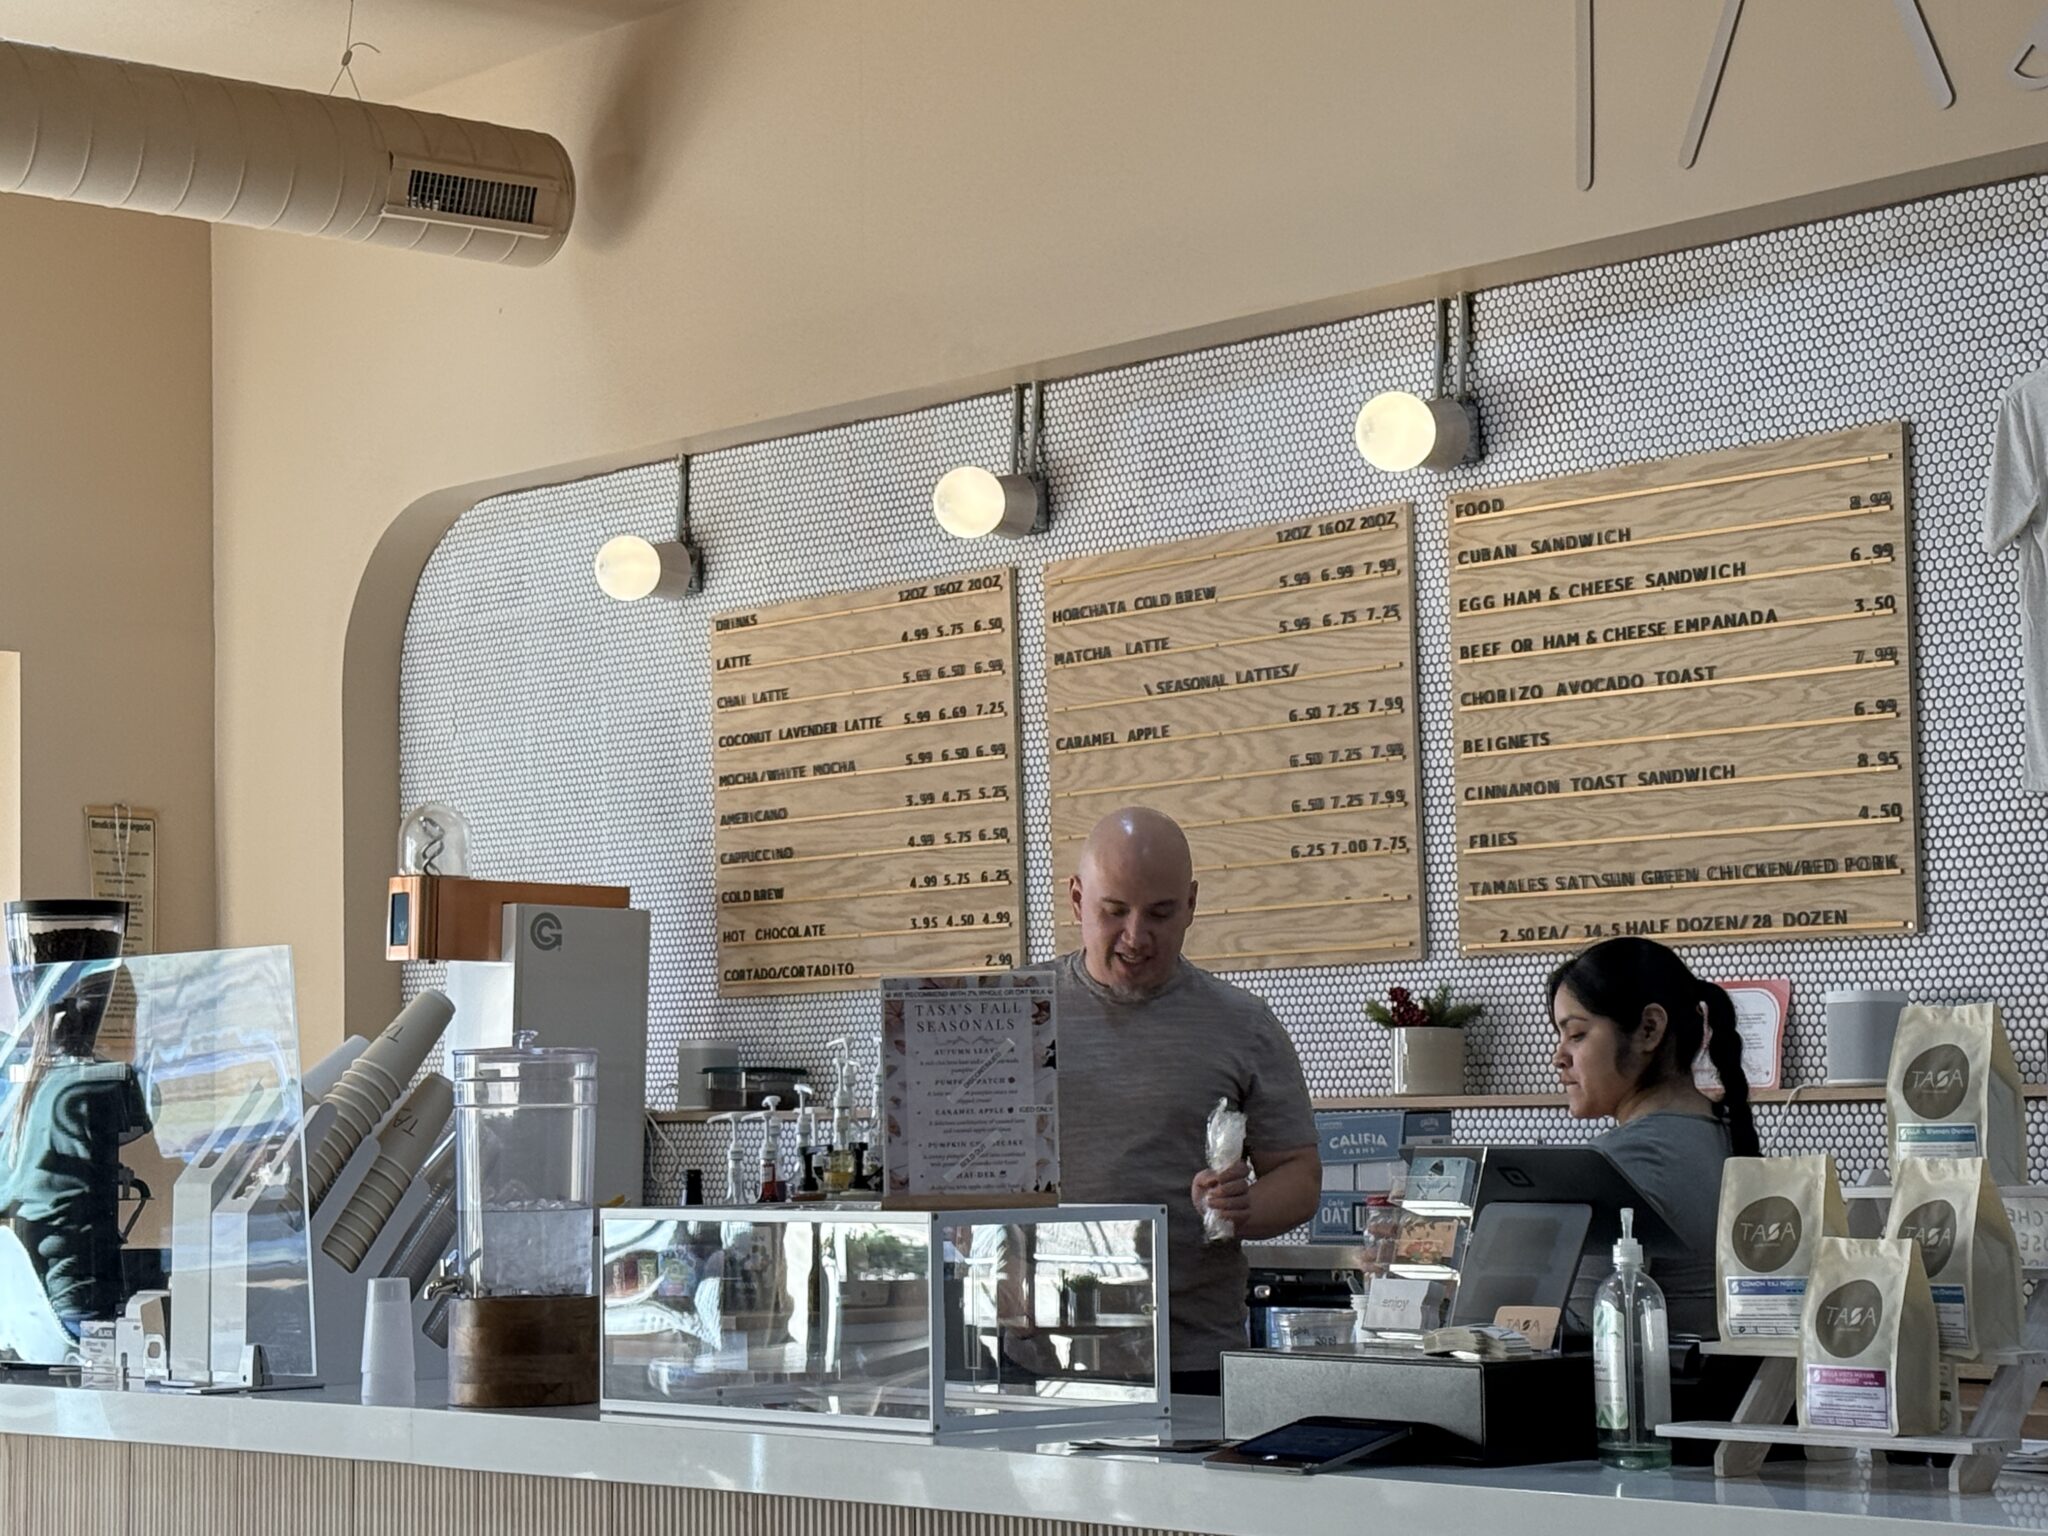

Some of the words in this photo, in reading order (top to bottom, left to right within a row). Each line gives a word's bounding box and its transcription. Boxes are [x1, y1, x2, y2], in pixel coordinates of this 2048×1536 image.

[1455, 498, 1504, 518] FOOD
[1457, 543, 1517, 566] CUBAN
[1530, 527, 1632, 556] SANDWICH
[1052, 601, 1126, 624] HORCHATA
[1134, 593, 1172, 611] COLD
[1175, 586, 1217, 604] BREW
[1279, 571, 1310, 589] 5.99
[1320, 564, 1354, 582] 6.99
[1363, 558, 1397, 575] 7.99
[1458, 594, 1495, 613] EGG
[1503, 589, 1541, 608] HAM
[1548, 586, 1560, 602] &
[1568, 576, 1634, 599] CHEESE
[1645, 562, 1746, 588] SANDWICH
[1850, 543, 1894, 562] 6.99
[716, 614, 757, 631] DRINKS
[1054, 646, 1112, 666] MATCHA
[1125, 637, 1170, 656] LATTE
[1278, 616, 1310, 633] 5.99
[1322, 610, 1357, 627] 6.75
[1367, 604, 1400, 621] 7.25
[1459, 641, 1501, 660] BEEF
[1510, 636, 1533, 653] OR
[1543, 631, 1580, 650] HAM
[1586, 628, 1598, 643] &
[1603, 621, 1667, 642] CHEESE
[1674, 608, 1778, 635] EMPANADA
[1854, 594, 1895, 613] 3.50
[717, 654, 752, 671] LATTE
[901, 628, 929, 643] 4.99
[936, 623, 964, 638] 5.75
[974, 617, 1002, 632] 6.50
[717, 692, 747, 709] CHAI
[752, 688, 790, 704] LATTE
[938, 664, 966, 679] 6.50
[974, 659, 1003, 675] 6.99
[1156, 673, 1228, 695] SEASONAL
[1460, 684, 1543, 707] CHORIZO
[1556, 675, 1644, 698] AVOCADO
[1655, 665, 1718, 687] TOAST
[1853, 646, 1897, 665] 7.99
[719, 730, 772, 748] COCONUT
[779, 722, 837, 740] LAVENDER
[845, 716, 883, 731] LATTE
[904, 710, 930, 725] 5.99
[939, 705, 967, 720] 6.69
[976, 701, 1005, 716] 7.25
[1056, 731, 1118, 751] CARAMEL
[1127, 725, 1170, 743] APPLE
[1289, 706, 1321, 722] 6.50
[1327, 701, 1360, 717] 7.25
[1369, 696, 1403, 713] 7.99
[1463, 732, 1550, 754] BEIGNETS
[1854, 698, 1898, 717] 6.99
[719, 766, 806, 786] MOCHA/WHITE
[813, 760, 856, 775] MOCHA
[905, 752, 933, 766] 5.99
[941, 748, 969, 762] 6.50
[976, 743, 1006, 758] 6.99
[1289, 752, 1323, 767] 6.50
[1329, 748, 1363, 762] 7.25
[1371, 743, 1404, 758] 7.99
[1465, 779, 1560, 801] CINNAMON
[1570, 773, 1627, 792] TOAST
[1637, 765, 1735, 787] SANDWICH
[1857, 751, 1899, 769] 8.95
[720, 807, 788, 826] AMERICANO
[905, 792, 935, 807] 3.99
[942, 789, 971, 803] 4.75
[978, 785, 1007, 799] 5.25
[1291, 797, 1325, 812] 6.50
[1330, 793, 1364, 809] 7.25
[1369, 789, 1406, 806] 7.99
[1469, 832, 1518, 849] FRIES
[1858, 802, 1903, 820] 4.50
[720, 847, 793, 865] CAPPUCCINO
[907, 834, 935, 848] 4.99
[944, 831, 971, 844] 5.75
[979, 827, 1008, 841] 6.50
[1290, 843, 1325, 858] 6.25
[1331, 839, 1368, 855] 7.00
[1372, 836, 1407, 851] 7.75
[721, 890, 750, 904] COLD
[753, 887, 784, 901] BREW
[910, 875, 937, 889] 4.99
[944, 872, 970, 886] 5.75
[981, 869, 1010, 883] 6.25
[1470, 876, 1548, 897] TAMALES
[1641, 866, 1700, 885] GREEN
[1707, 857, 1839, 882] CHICKEN/RED
[1844, 854, 1898, 873] PORK
[723, 929, 745, 943] HOT
[755, 924, 826, 940] CHOCOLATE
[910, 916, 938, 930] 3.95
[946, 914, 974, 927] 4.50
[982, 911, 1010, 925] 4.99
[1499, 923, 1535, 943] 2.50
[1584, 922, 1621, 939] 14.5
[1625, 918, 1670, 936] HALF
[1783, 909, 1848, 928] DOZEN
[724, 963, 854, 982] CORTADO/CORTADITO
[985, 953, 1012, 967] 2.99
[914, 1002, 973, 1017] TASA'S
[980, 1000, 1022, 1015] FALL
[916, 1018, 1016, 1033] SEASONALS
[1911, 1070, 1964, 1090] TASA
[1329, 1133, 1388, 1149] CALIFIA
[1343, 1147, 1376, 1155] FARMS
[1321, 1207, 1349, 1224] OAT
[1740, 1222, 1797, 1242] TASA
[1825, 1306, 1877, 1327] TASA
